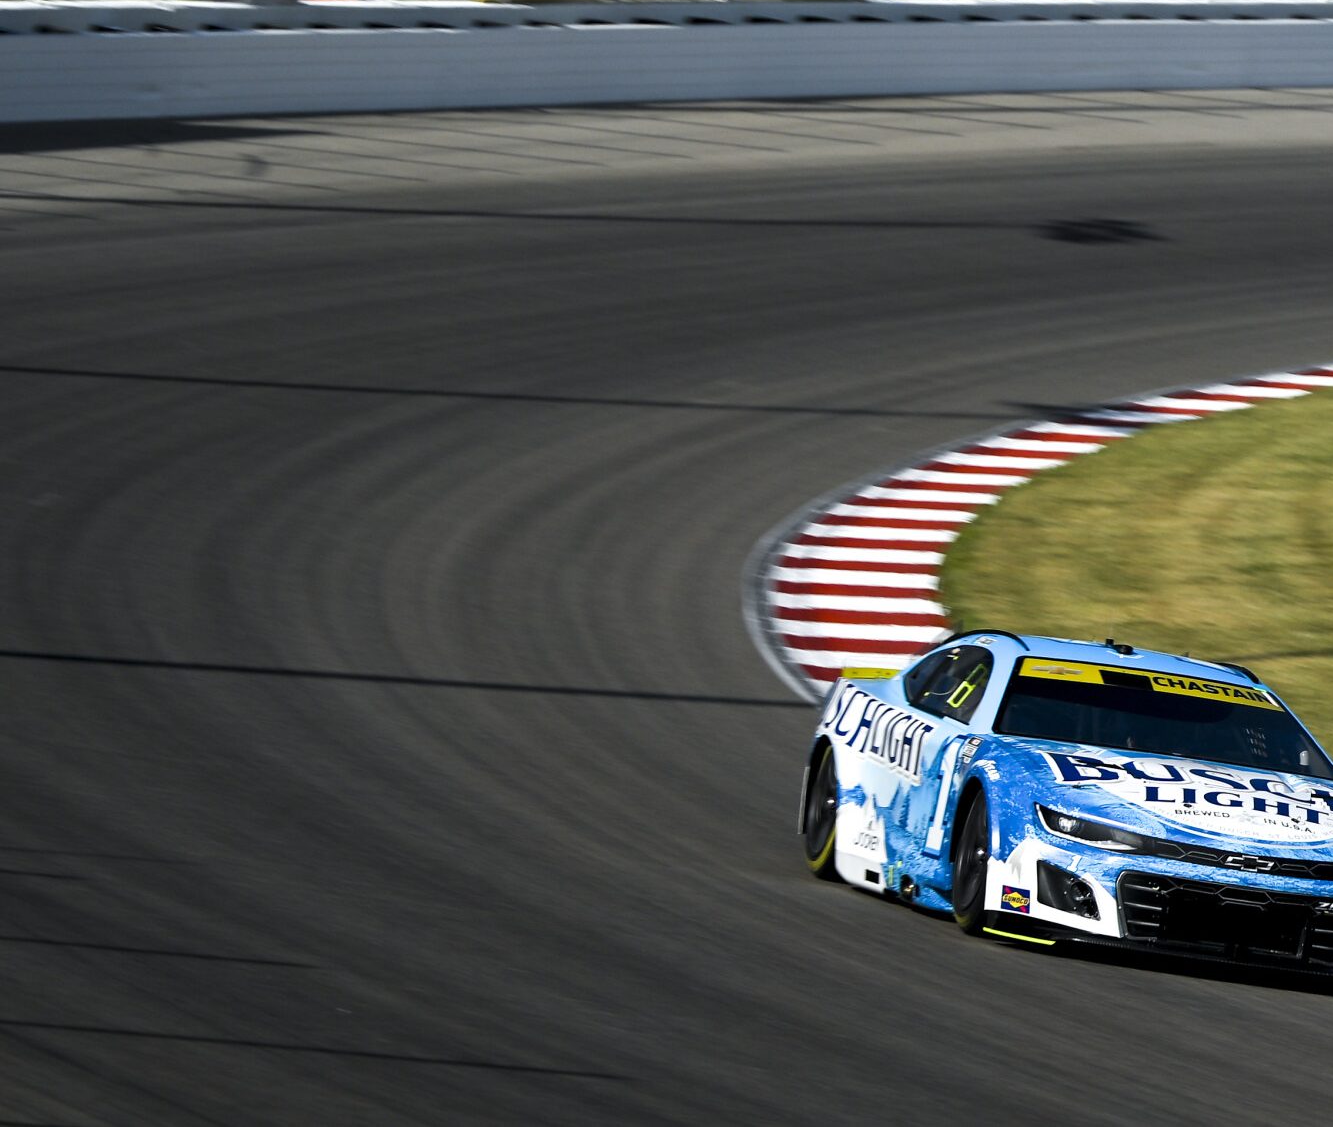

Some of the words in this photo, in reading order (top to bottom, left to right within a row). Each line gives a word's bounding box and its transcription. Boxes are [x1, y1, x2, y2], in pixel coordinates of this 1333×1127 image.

[1152, 675, 1274, 705] CHASTAIN
[1145, 786, 1330, 825] LIGHT
[1174, 808, 1231, 819] BREWED
[1263, 817, 1277, 825] IN
[1003, 894, 1029, 906] SUNOCO
